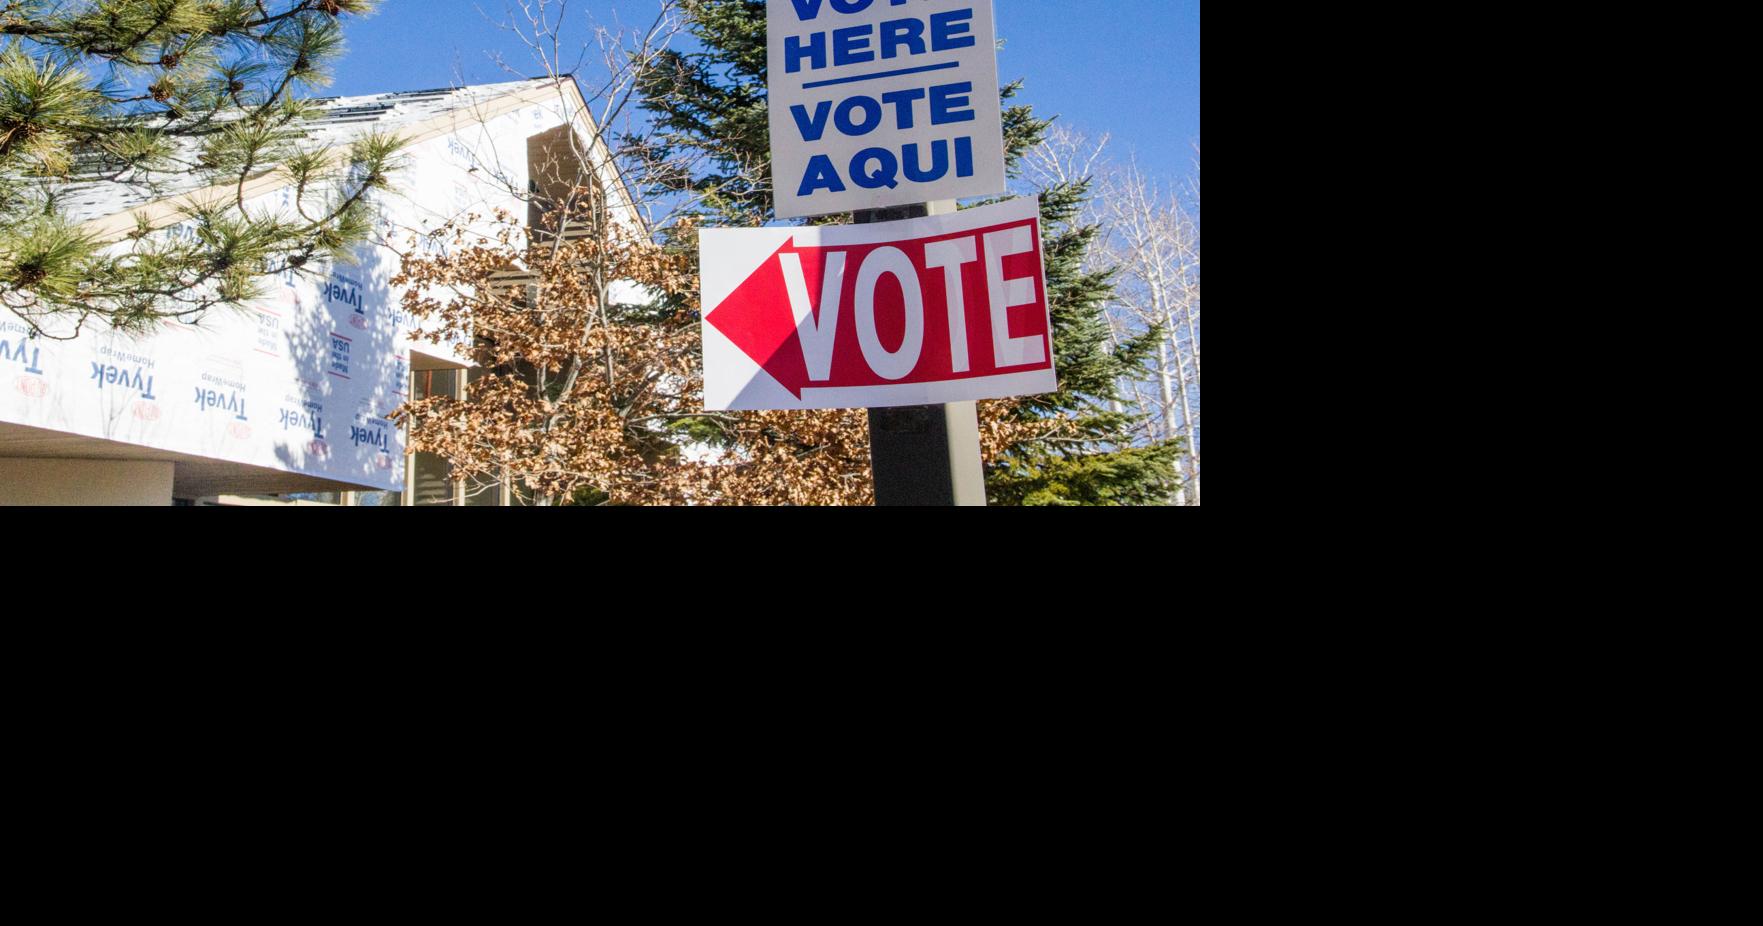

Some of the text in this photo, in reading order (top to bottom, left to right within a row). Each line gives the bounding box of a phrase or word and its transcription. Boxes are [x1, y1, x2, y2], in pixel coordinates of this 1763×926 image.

[784, 8, 976, 73] HERE
[789, 81, 976, 142] VOTE
[796, 136, 974, 196] AQUI
[323, 282, 365, 314] Tyvek
[777, 224, 1047, 382] VOTE
[100, 346, 155, 368] HomeWrap
[332, 338, 350, 353] USA
[89, 361, 156, 400] Tyvek
[200, 372, 246, 392] HomeWrap
[194, 387, 248, 421] Tyvek
[279, 408, 324, 439] Tyvek
[350, 425, 390, 454] Tyvek
